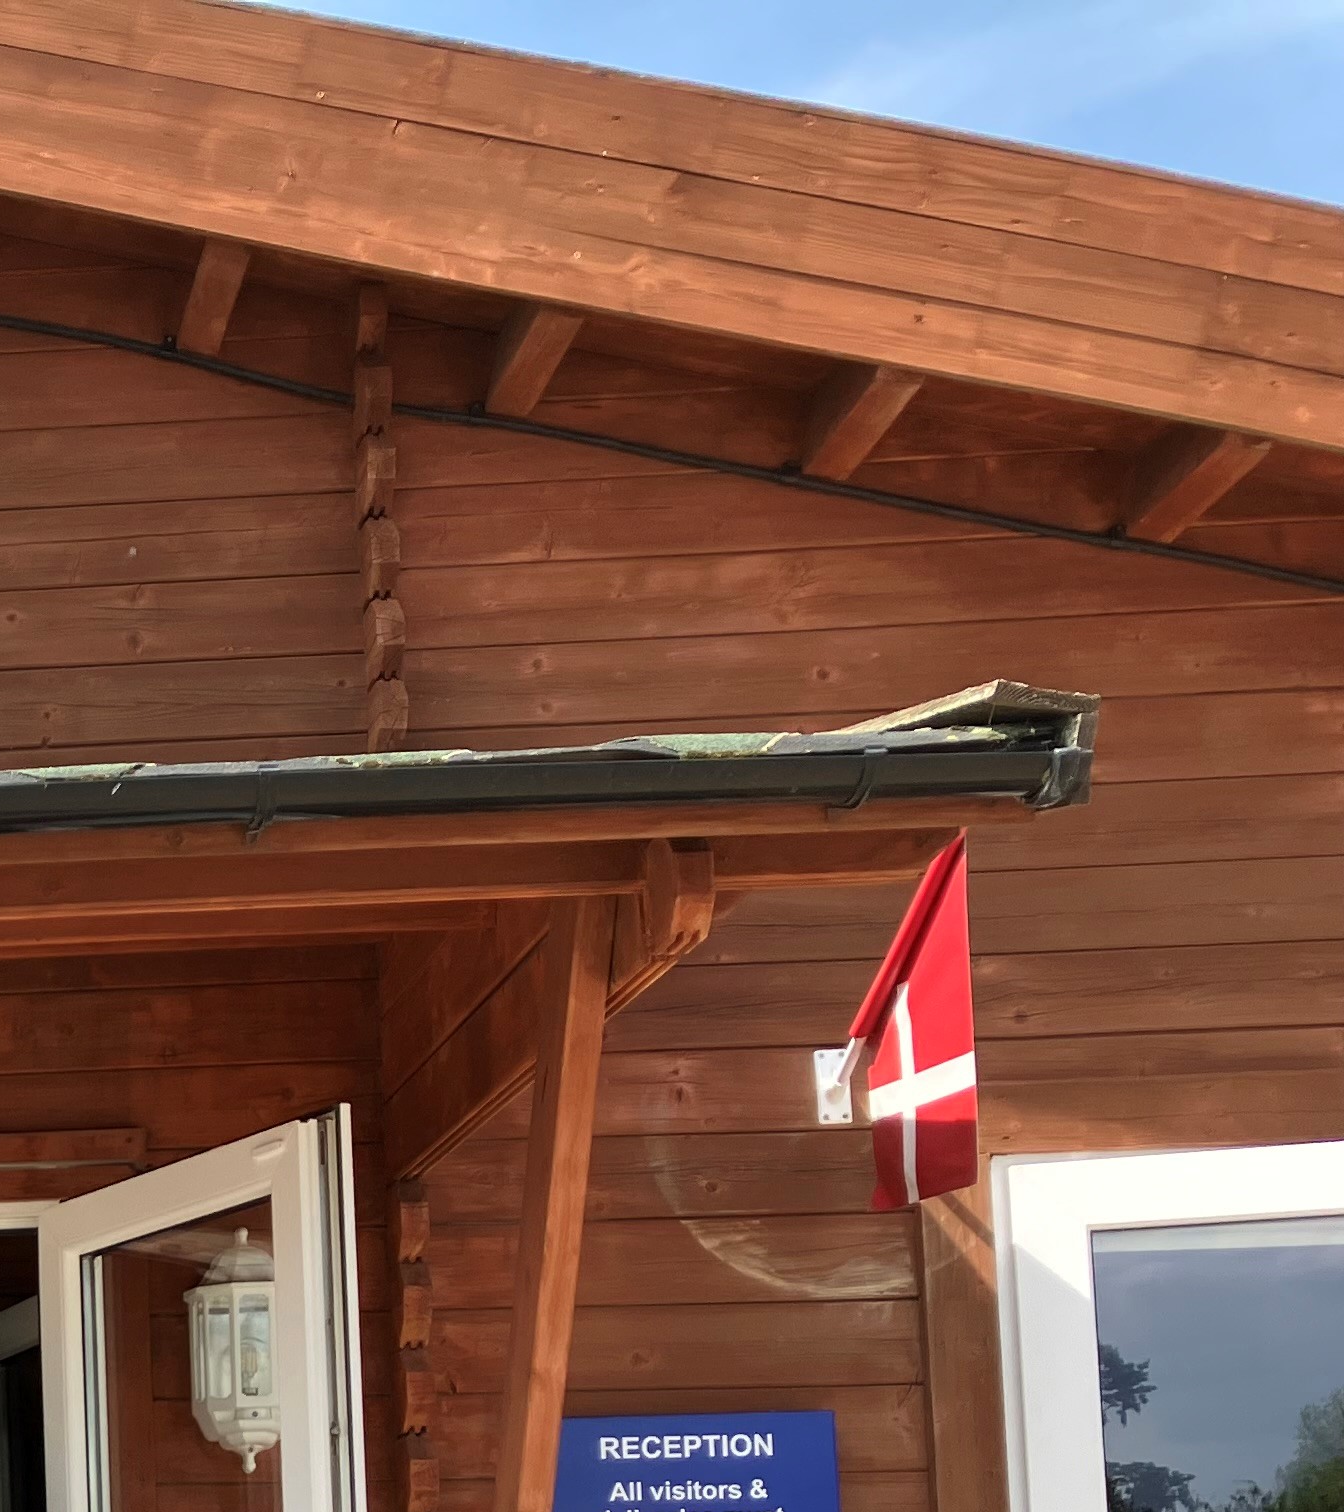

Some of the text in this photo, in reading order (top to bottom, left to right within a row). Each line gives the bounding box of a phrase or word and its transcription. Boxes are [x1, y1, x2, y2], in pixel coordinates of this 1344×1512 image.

[598, 1432, 775, 1460] RECEPTION
[609, 1478, 769, 1502] All visitors &
